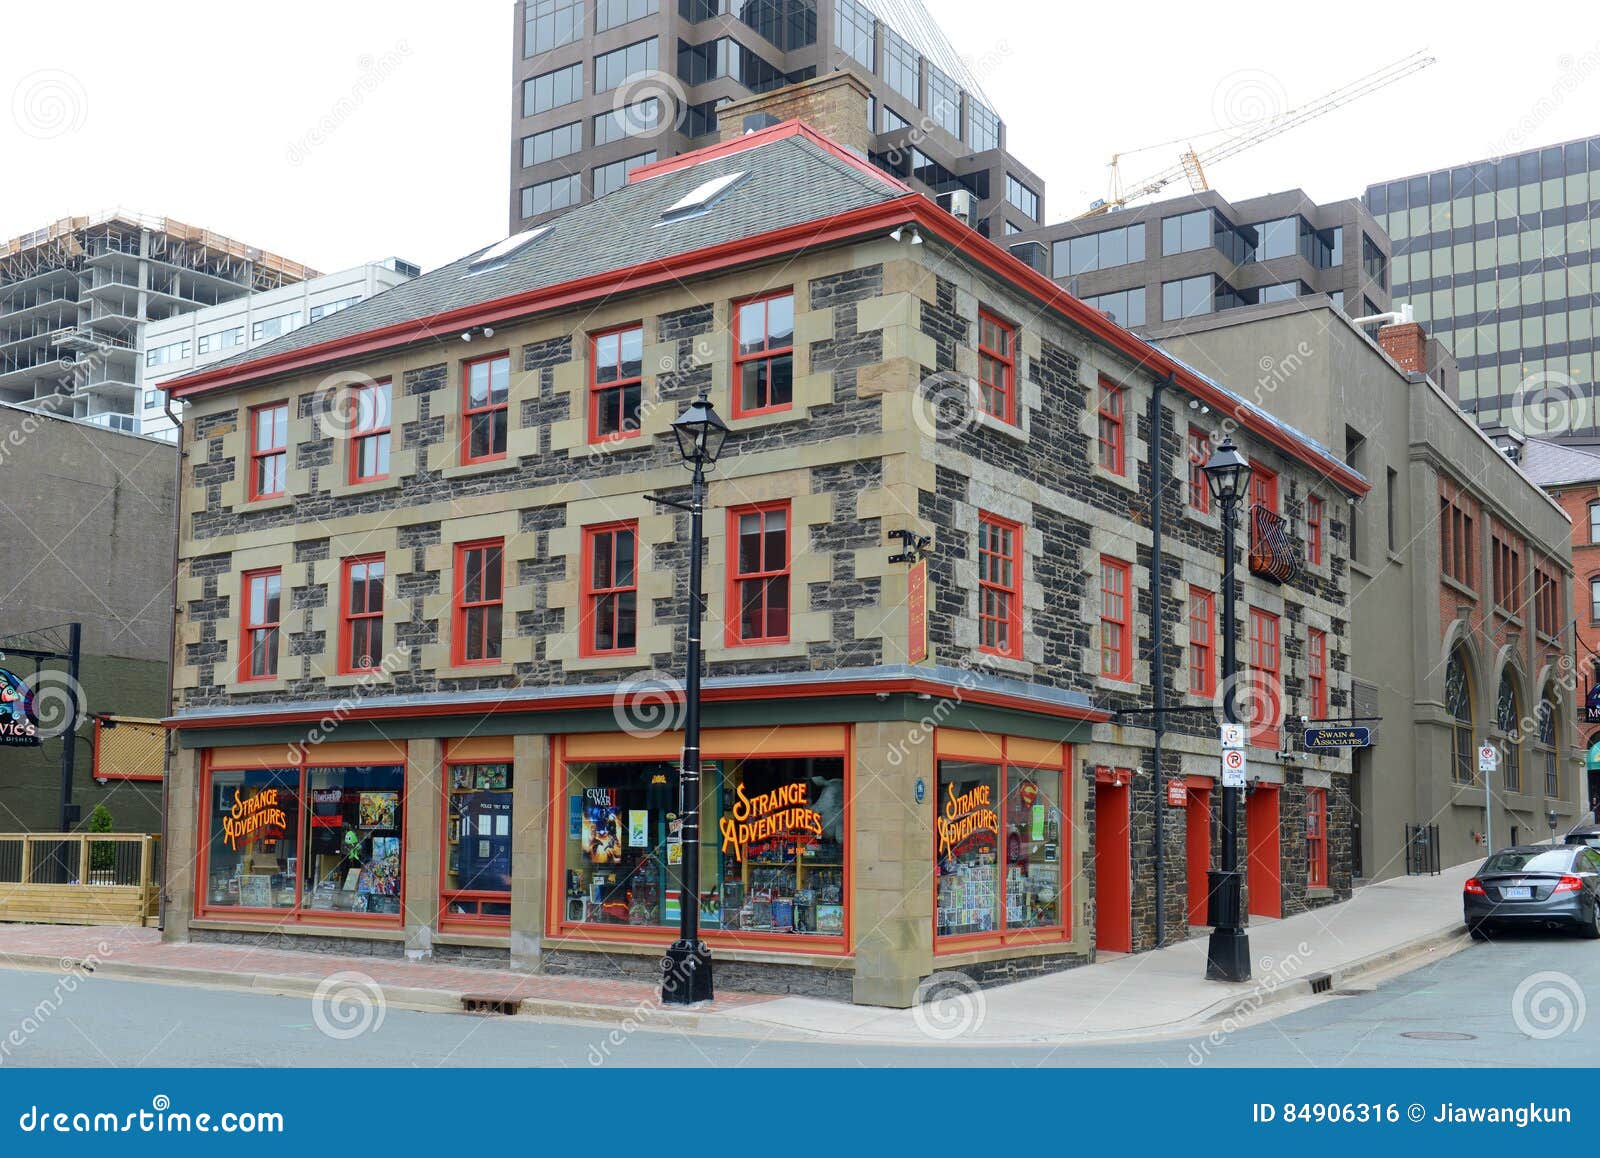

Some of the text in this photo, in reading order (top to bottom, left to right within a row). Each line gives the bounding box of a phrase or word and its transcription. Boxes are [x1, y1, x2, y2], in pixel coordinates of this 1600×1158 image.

[1313, 737, 1361, 746] ASSOCIATES
[1318, 730, 1347, 738] SWAIN
[231, 789, 278, 819] STRANGE
[586, 788, 606, 799] CIVIL
[594, 796, 611, 806] WAR
[733, 782, 807, 821] STRANGE
[946, 781, 990, 820] STRANGE
[223, 808, 286, 850] ADVENTURES
[719, 808, 823, 862] ADVENTURES
[937, 808, 998, 861] ADVENTURES
